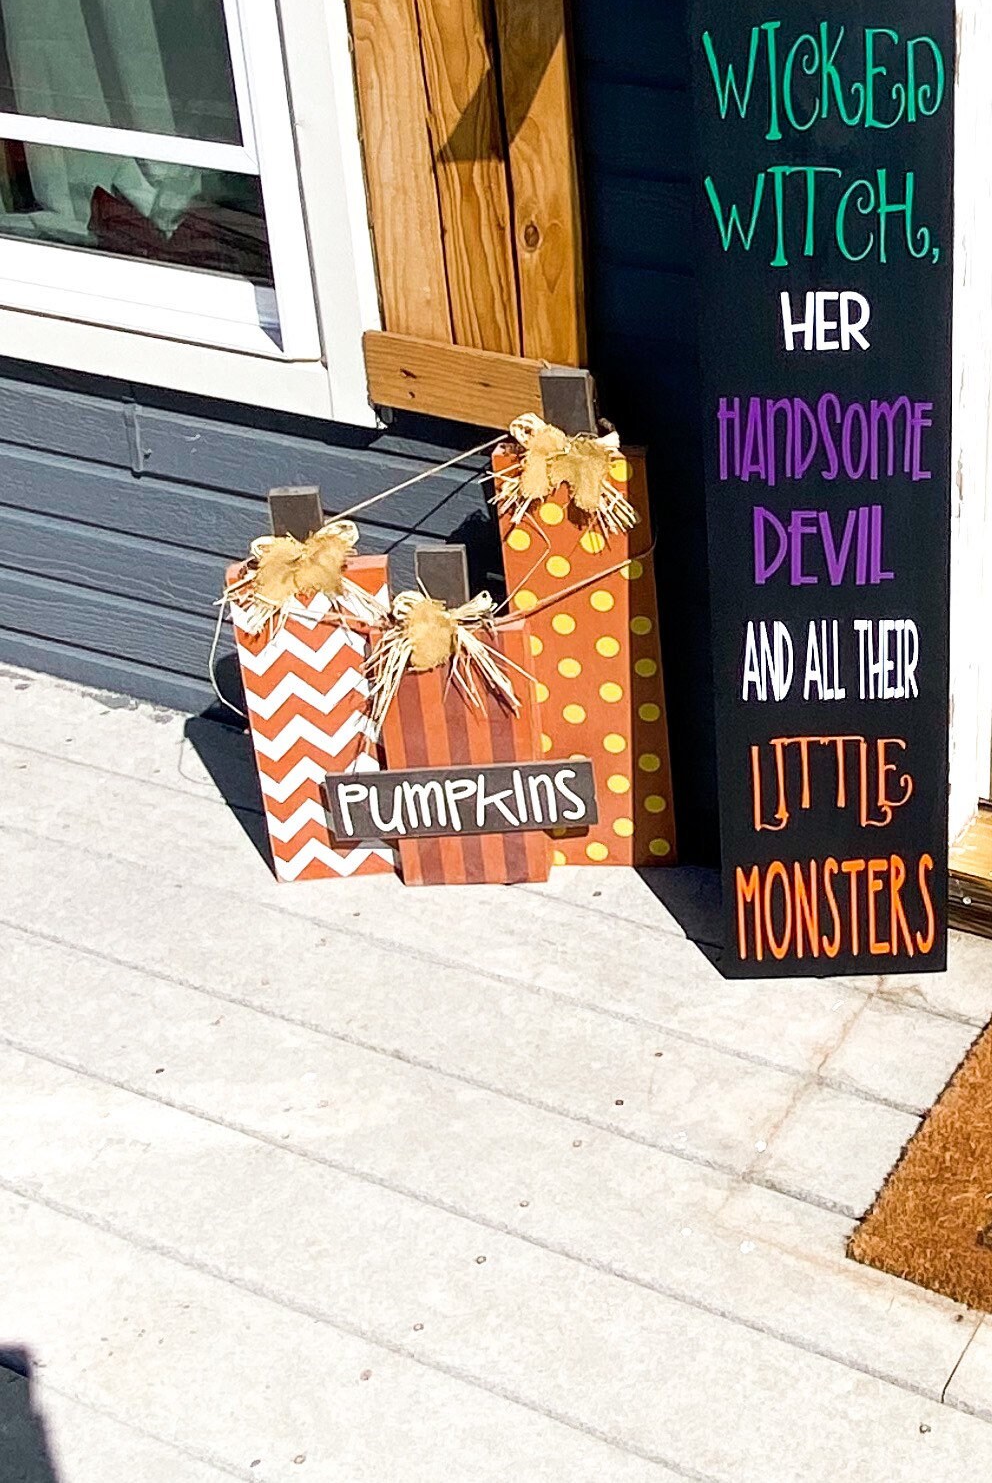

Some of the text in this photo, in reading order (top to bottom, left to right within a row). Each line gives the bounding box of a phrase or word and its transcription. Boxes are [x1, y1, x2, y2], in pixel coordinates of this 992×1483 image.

[702, 20, 945, 141] WICKED
[704, 165, 940, 267] WITCH,
[780, 291, 870, 351] HER
[717, 393, 933, 486] HANDSOME
[752, 505, 894, 586] DEVIL
[741, 619, 919, 703] AND ALL THEIR
[750, 735, 914, 833] LITTLE
[735, 853, 935, 961] MONSTERS
